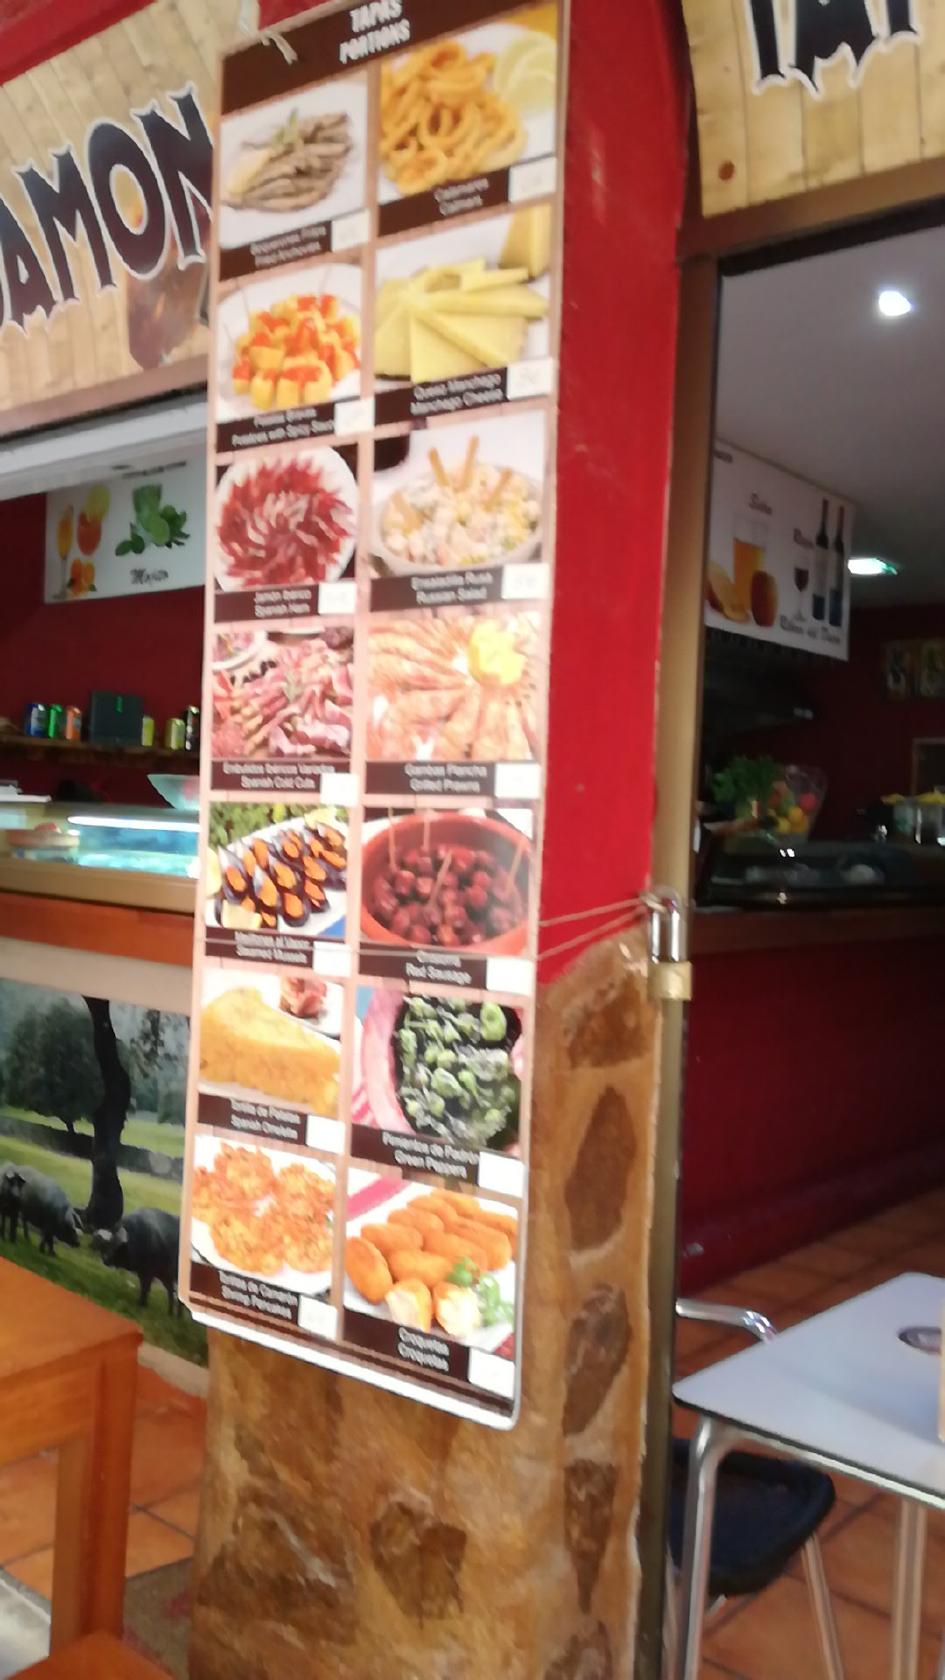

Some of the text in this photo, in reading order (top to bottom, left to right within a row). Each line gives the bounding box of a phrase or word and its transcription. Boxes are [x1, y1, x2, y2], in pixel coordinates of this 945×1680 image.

[349, 0, 402, 33] TAPAS
[0, 82, 213, 331] AMON
[405, 961, 428, 978] Red
